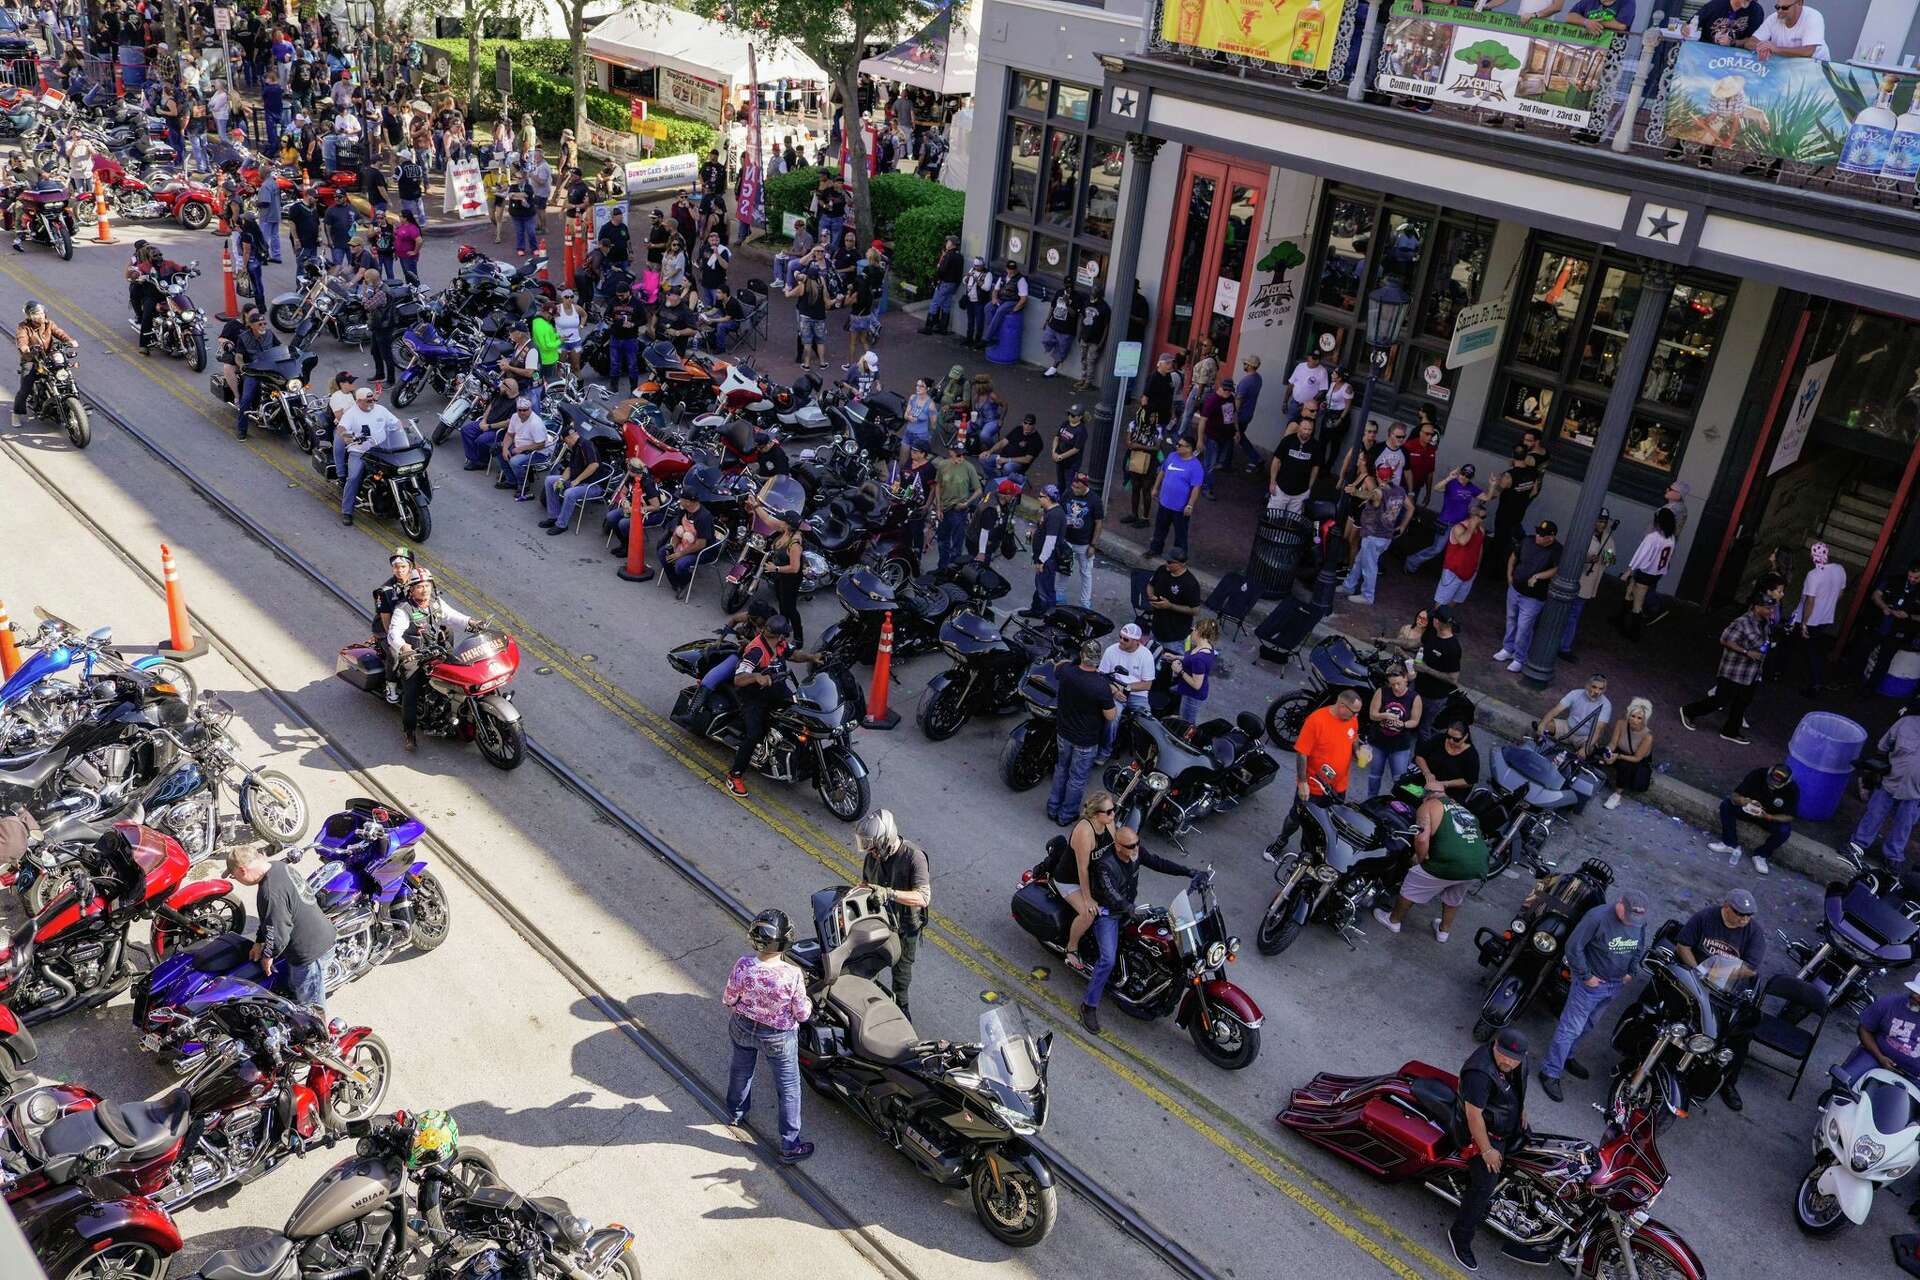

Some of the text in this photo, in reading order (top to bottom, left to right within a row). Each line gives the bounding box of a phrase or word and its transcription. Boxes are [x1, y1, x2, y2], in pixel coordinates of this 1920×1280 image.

[1708, 56, 1770, 78] CORAZON
[1389, 77, 1437, 96] Come on up!
[1519, 102, 1581, 122] 2nd Floor 23rd St
[1247, 309, 1271, 320] SECOND
[1456, 313, 1479, 331] Santa
[1608, 936, 1639, 948] Indian
[351, 1190, 385, 1210] INDIAN
